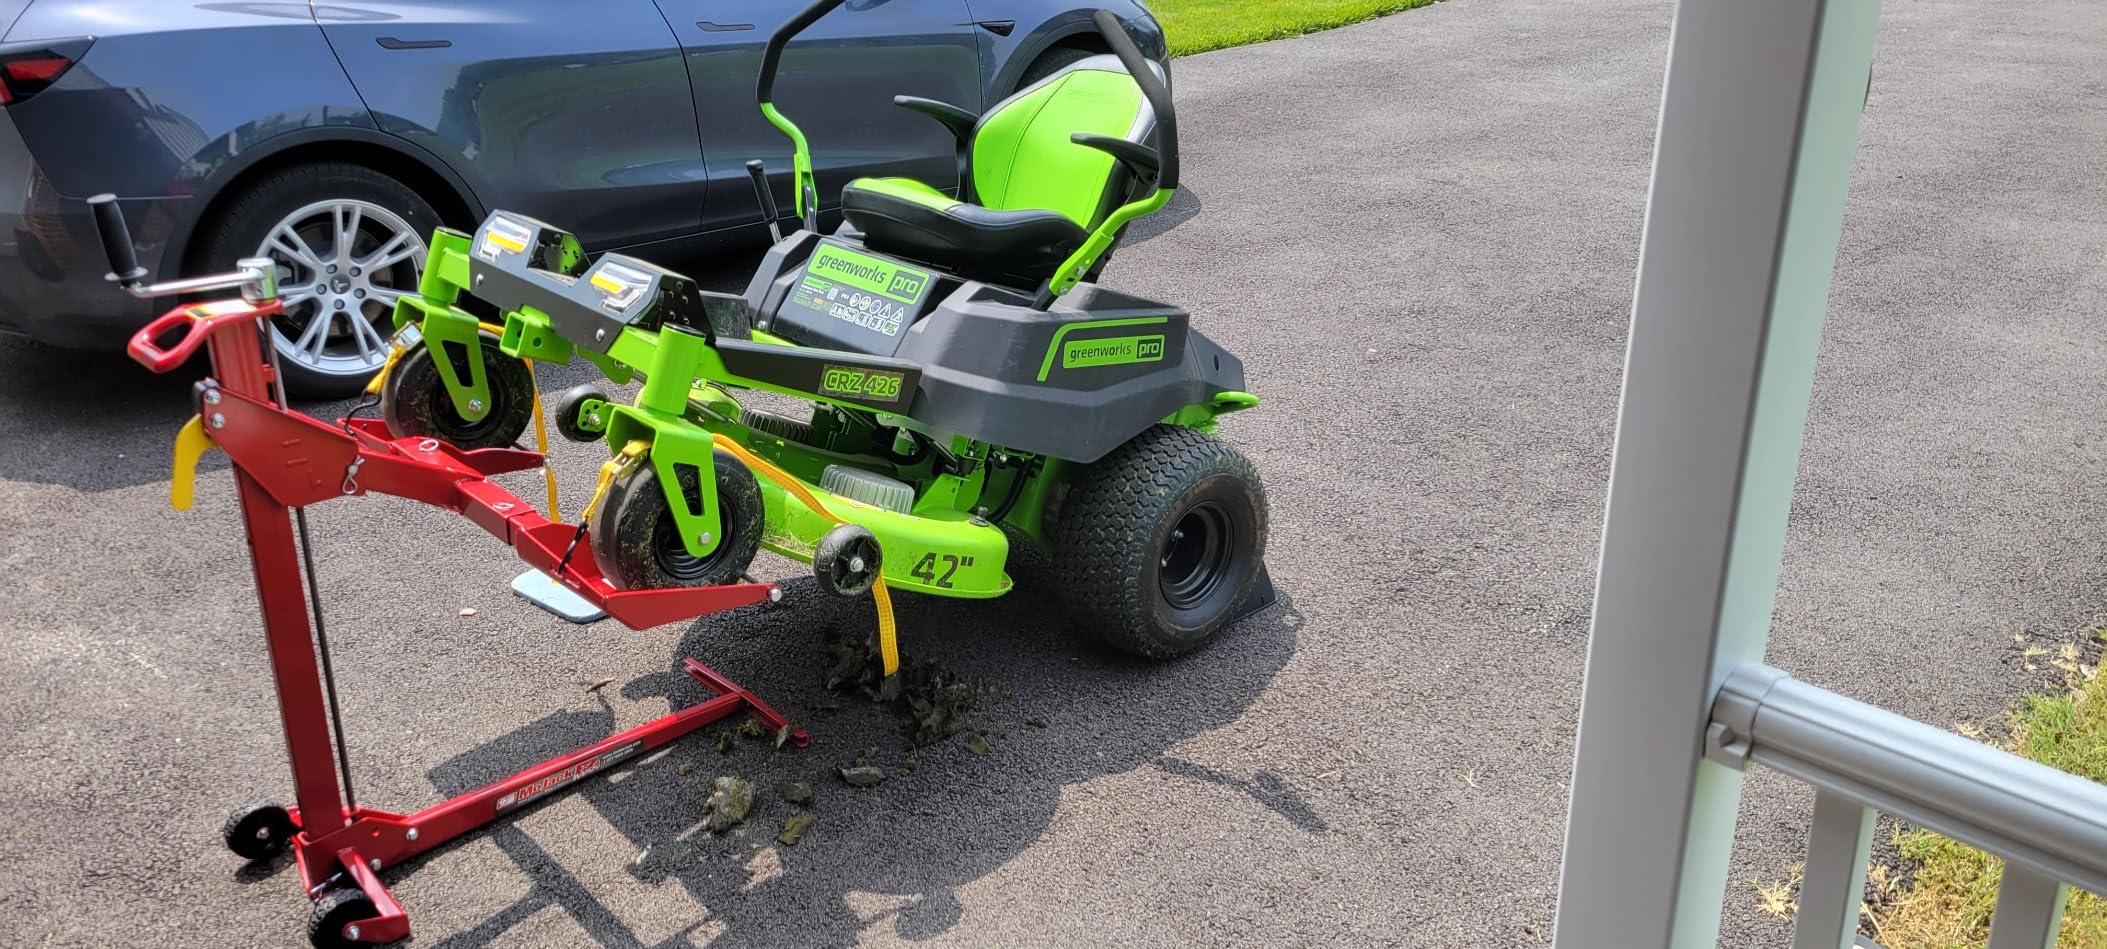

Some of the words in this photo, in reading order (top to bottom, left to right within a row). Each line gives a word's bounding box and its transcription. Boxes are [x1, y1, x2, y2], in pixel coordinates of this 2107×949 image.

[816, 253, 887, 284] greenworks
[889, 275, 920, 294] pro
[1070, 342, 1132, 362] greenworks
[1138, 342, 1160, 358] pro
[824, 369, 865, 393] CRZ
[864, 375, 901, 396] 426
[910, 551, 975, 589] 42"
